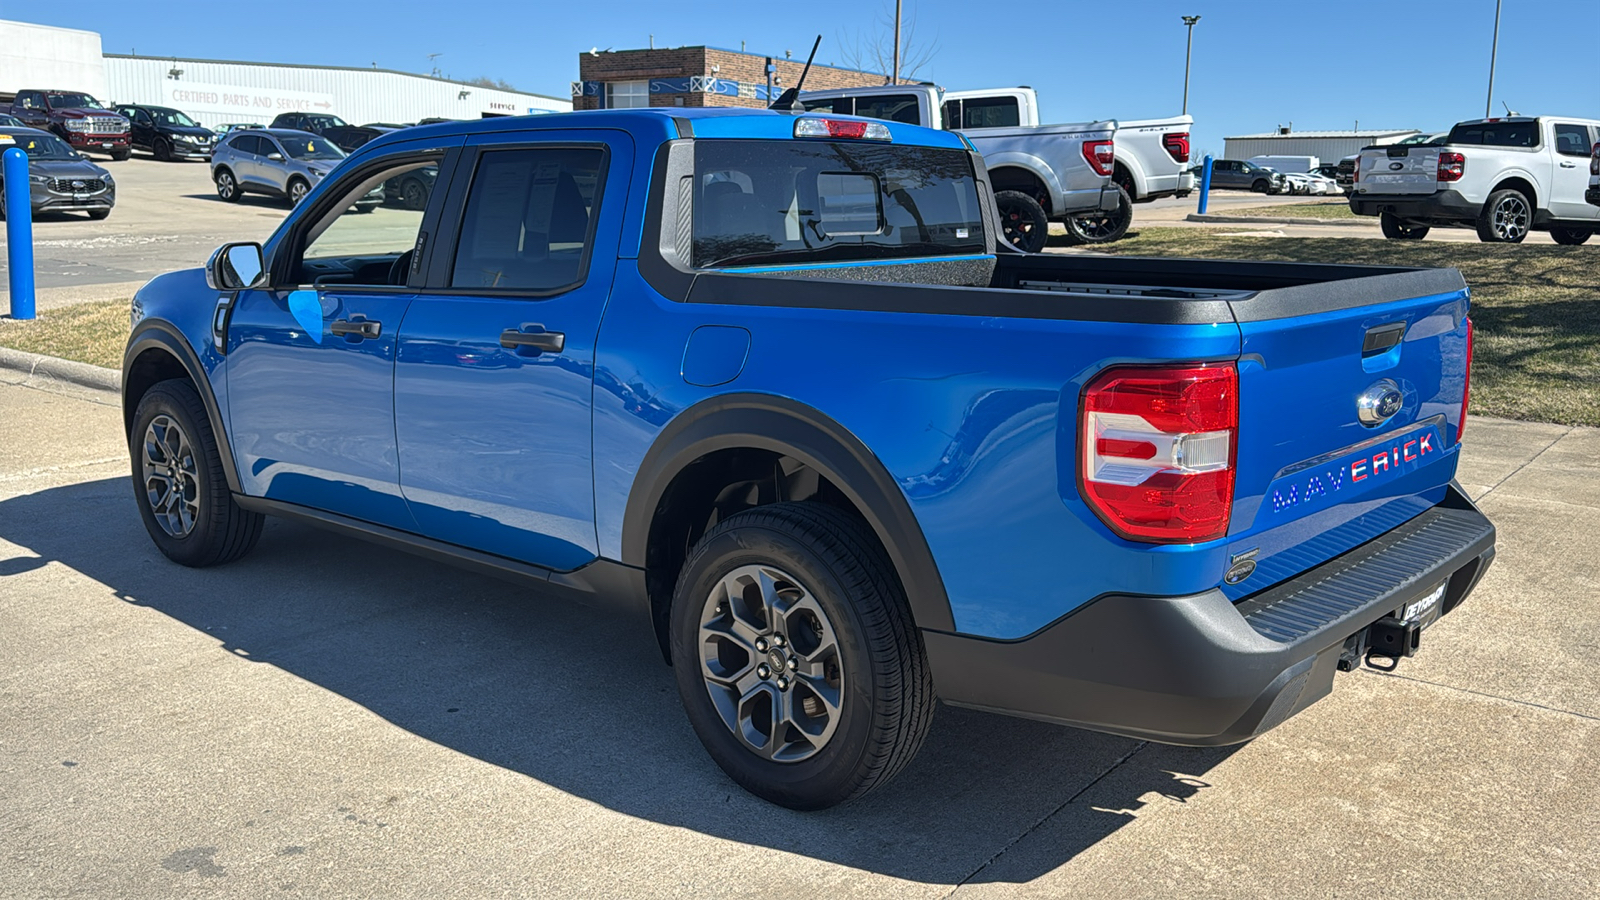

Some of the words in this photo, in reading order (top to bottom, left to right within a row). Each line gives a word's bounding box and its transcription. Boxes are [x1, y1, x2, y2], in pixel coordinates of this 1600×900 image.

[172, 89, 219, 104] CERTIFIED
[223, 93, 250, 107] PARTS
[252, 96, 272, 108] AND
[276, 98, 310, 110] SERVICE
[489, 102, 516, 111] SERVICE
[1272, 432, 1434, 514] MAVERICK
